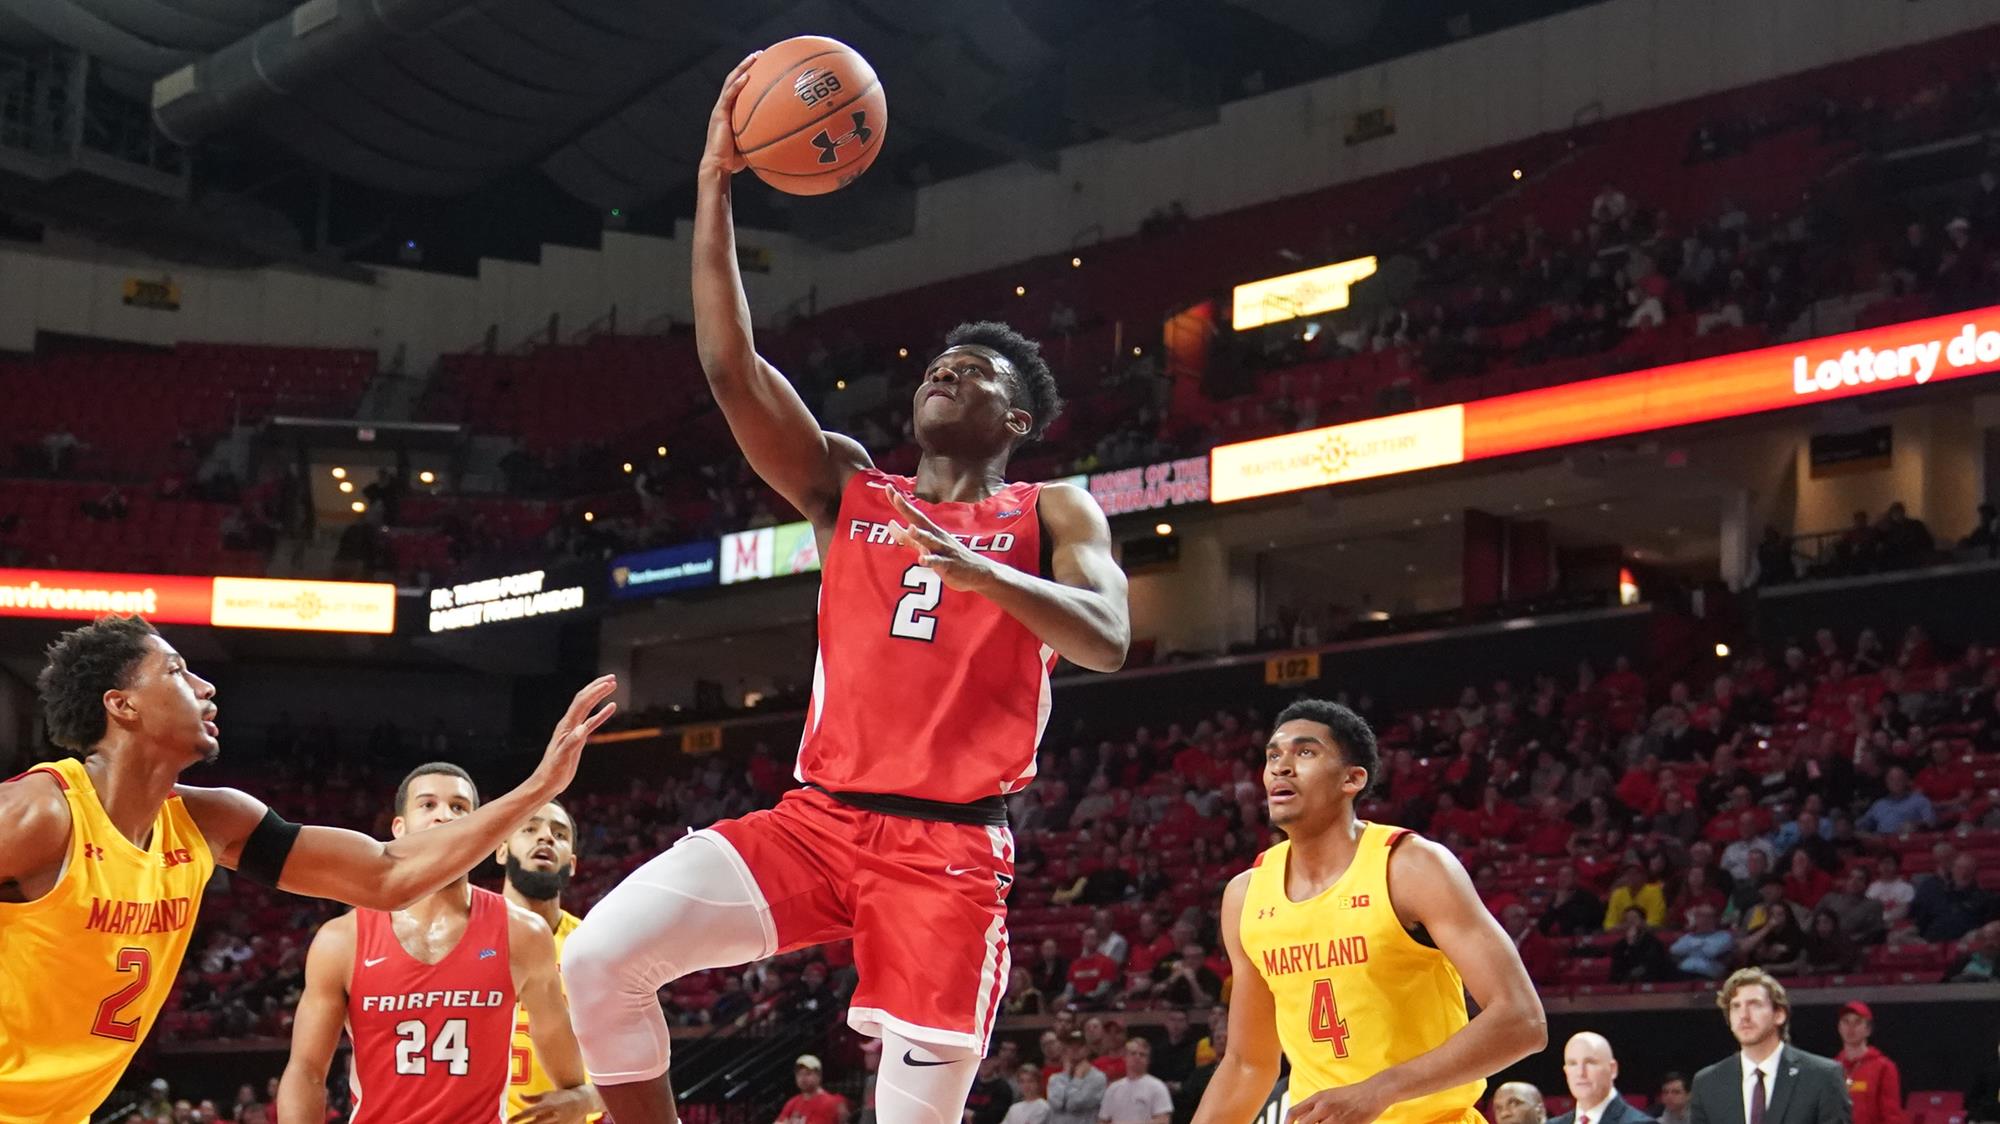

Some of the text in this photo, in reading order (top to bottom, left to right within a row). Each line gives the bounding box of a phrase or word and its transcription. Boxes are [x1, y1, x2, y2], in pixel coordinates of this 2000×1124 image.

[1793, 341, 1941, 394] Lottery
[889, 563, 942, 643] 2
[86, 897, 191, 935] MARYLAND
[1263, 936, 1369, 977] MARYLAND
[91, 947, 152, 1042] 2
[362, 990, 503, 1013] FAIRFIELD
[1308, 978, 1350, 1059] 4
[395, 1017, 470, 1077] 24
